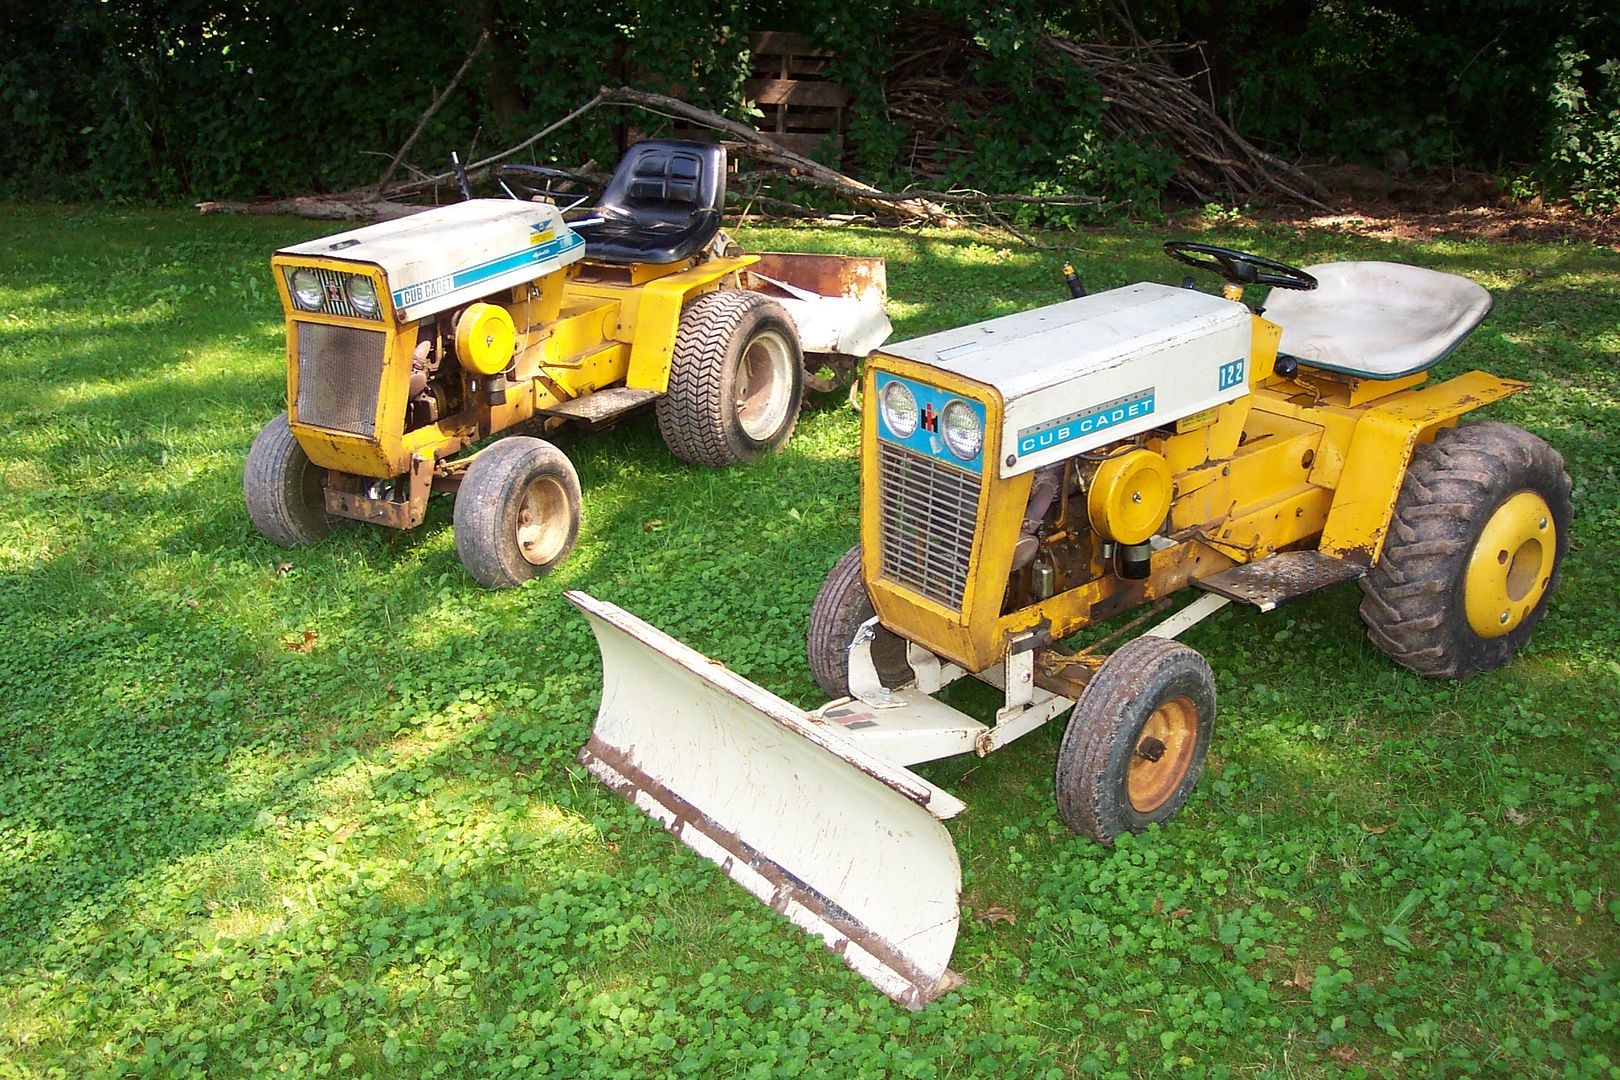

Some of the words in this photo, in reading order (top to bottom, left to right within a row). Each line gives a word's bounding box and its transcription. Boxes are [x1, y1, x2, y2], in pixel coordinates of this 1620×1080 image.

[404, 287, 423, 304] CUB
[424, 277, 451, 298] CADET
[1221, 361, 1243, 387] 122
[1022, 427, 1071, 452] CUB
[1080, 399, 1153, 432] CADET
